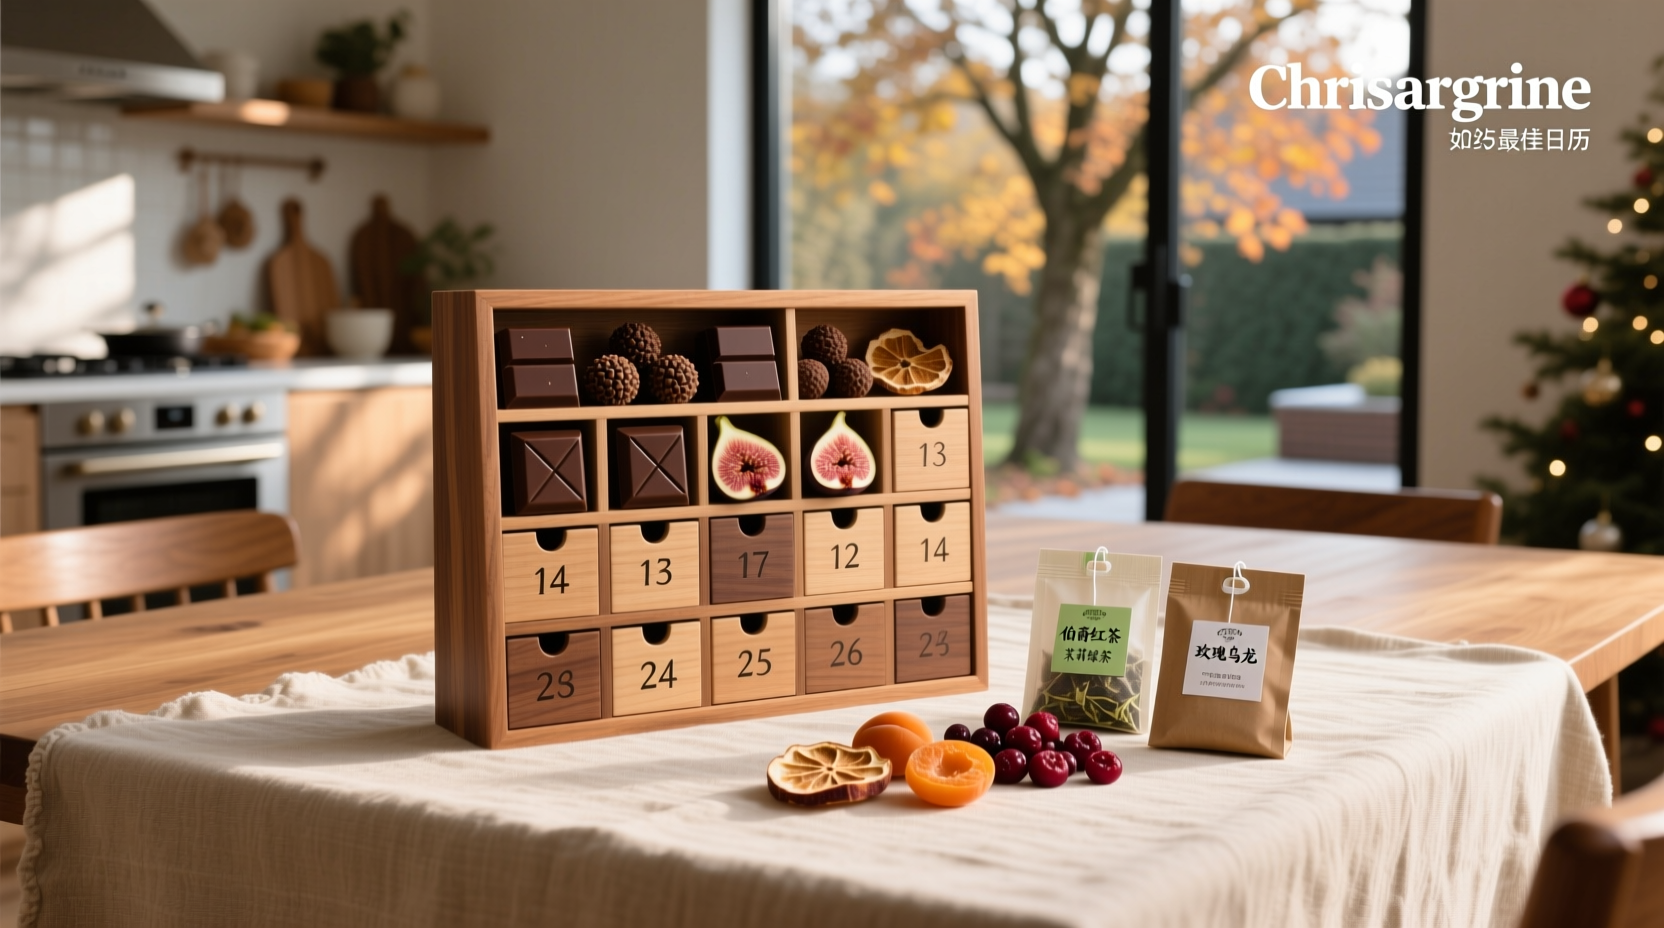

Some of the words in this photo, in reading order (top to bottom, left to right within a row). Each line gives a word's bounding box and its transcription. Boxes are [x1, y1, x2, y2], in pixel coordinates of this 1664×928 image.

[919, 441, 947, 468] 13
[738, 550, 770, 579] 17
[830, 542, 860, 570] 12
[920, 536, 950, 564] 14
[534, 565, 570, 596] 14
[640, 558, 673, 587] 13
[737, 648, 772, 679] 25
[830, 638, 863, 668] 26
[1194, 643, 1258, 665] 玫瑰乌龙
[640, 659, 678, 691] 24
